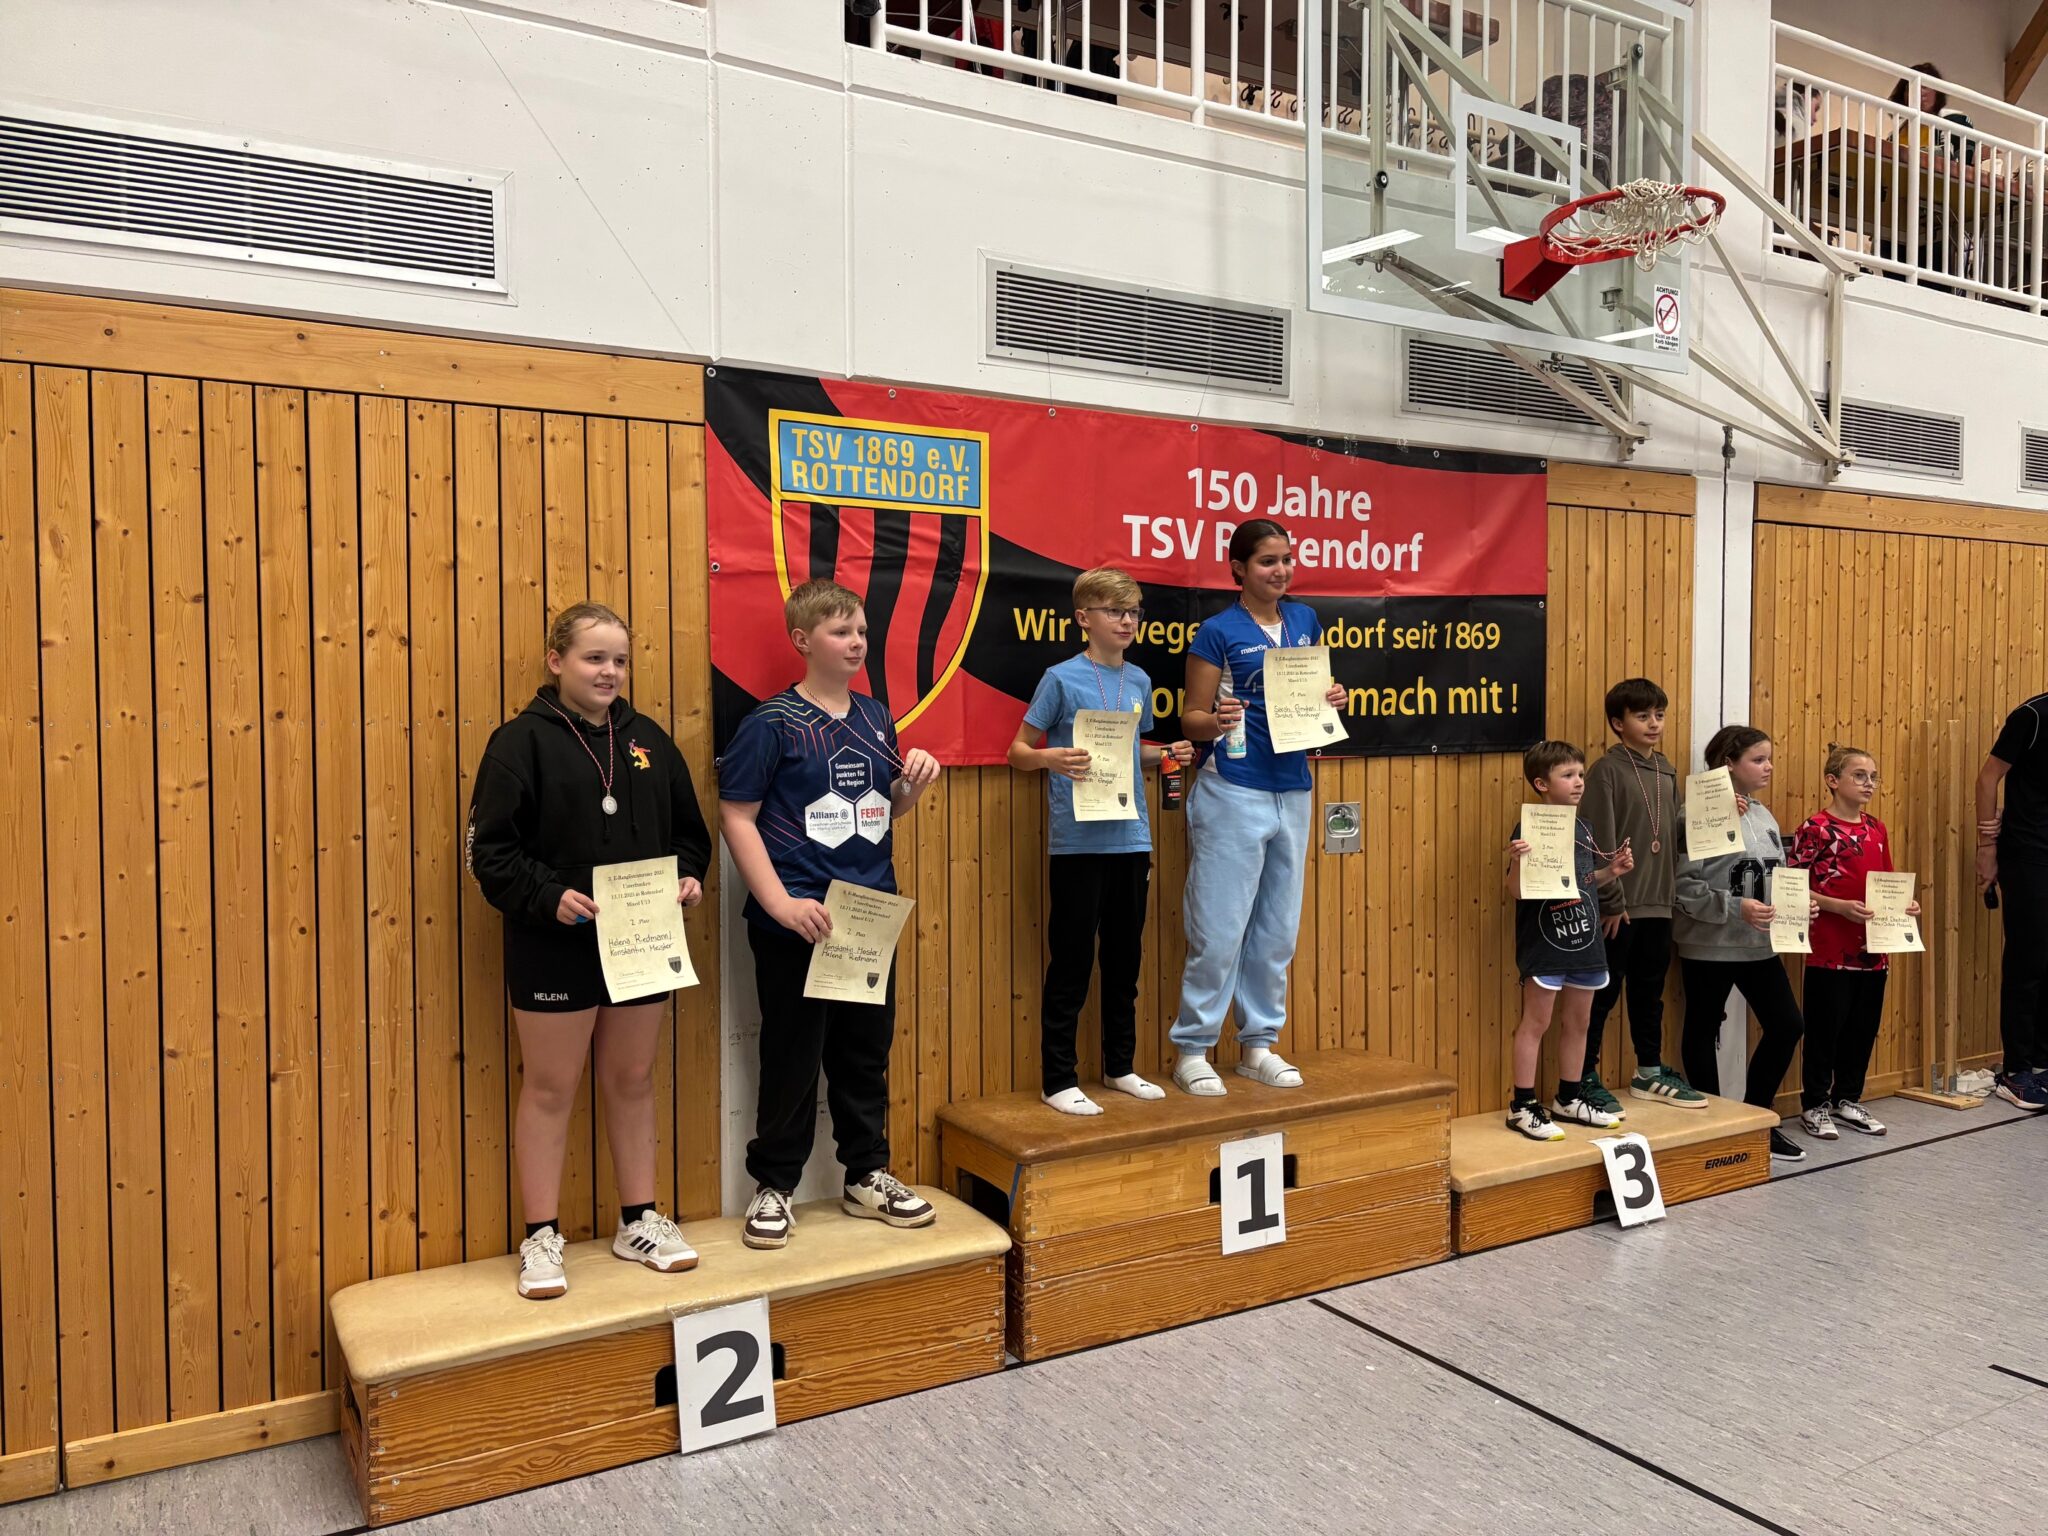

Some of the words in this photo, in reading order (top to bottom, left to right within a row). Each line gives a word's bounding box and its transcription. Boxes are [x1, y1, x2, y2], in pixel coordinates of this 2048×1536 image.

[791, 428, 843, 461] TSV
[853, 436, 915, 467] 1869
[927, 445, 970, 472] e.V.
[791, 460, 970, 501] ROTTENDORF
[1187, 467, 1258, 513] 150
[1267, 474, 1372, 521] Jahre
[1122, 514, 1205, 560] TSV
[1215, 521, 1424, 572] Rtendorf
[1013, 607, 1071, 642] Wir
[1392, 620, 1437, 649] seit
[1444, 622, 1500, 649] 1869
[1348, 676, 1437, 716] mach
[1448, 677, 1503, 714] mit
[835, 762, 865, 770] Gemeinsam
[836, 771, 857, 779] punkten
[846, 779, 865, 788] Region
[810, 811, 839, 820] Allianz
[861, 807, 885, 819] FERTIG
[1552, 904, 1587, 925] RUN
[1556, 919, 1590, 939] NUE
[533, 992, 569, 1001] HELENA
[1613, 1142, 1655, 1209] 3
[1704, 1152, 1748, 1170] ERHARD
[1237, 1157, 1280, 1235] 1
[696, 1330, 764, 1428] 2
